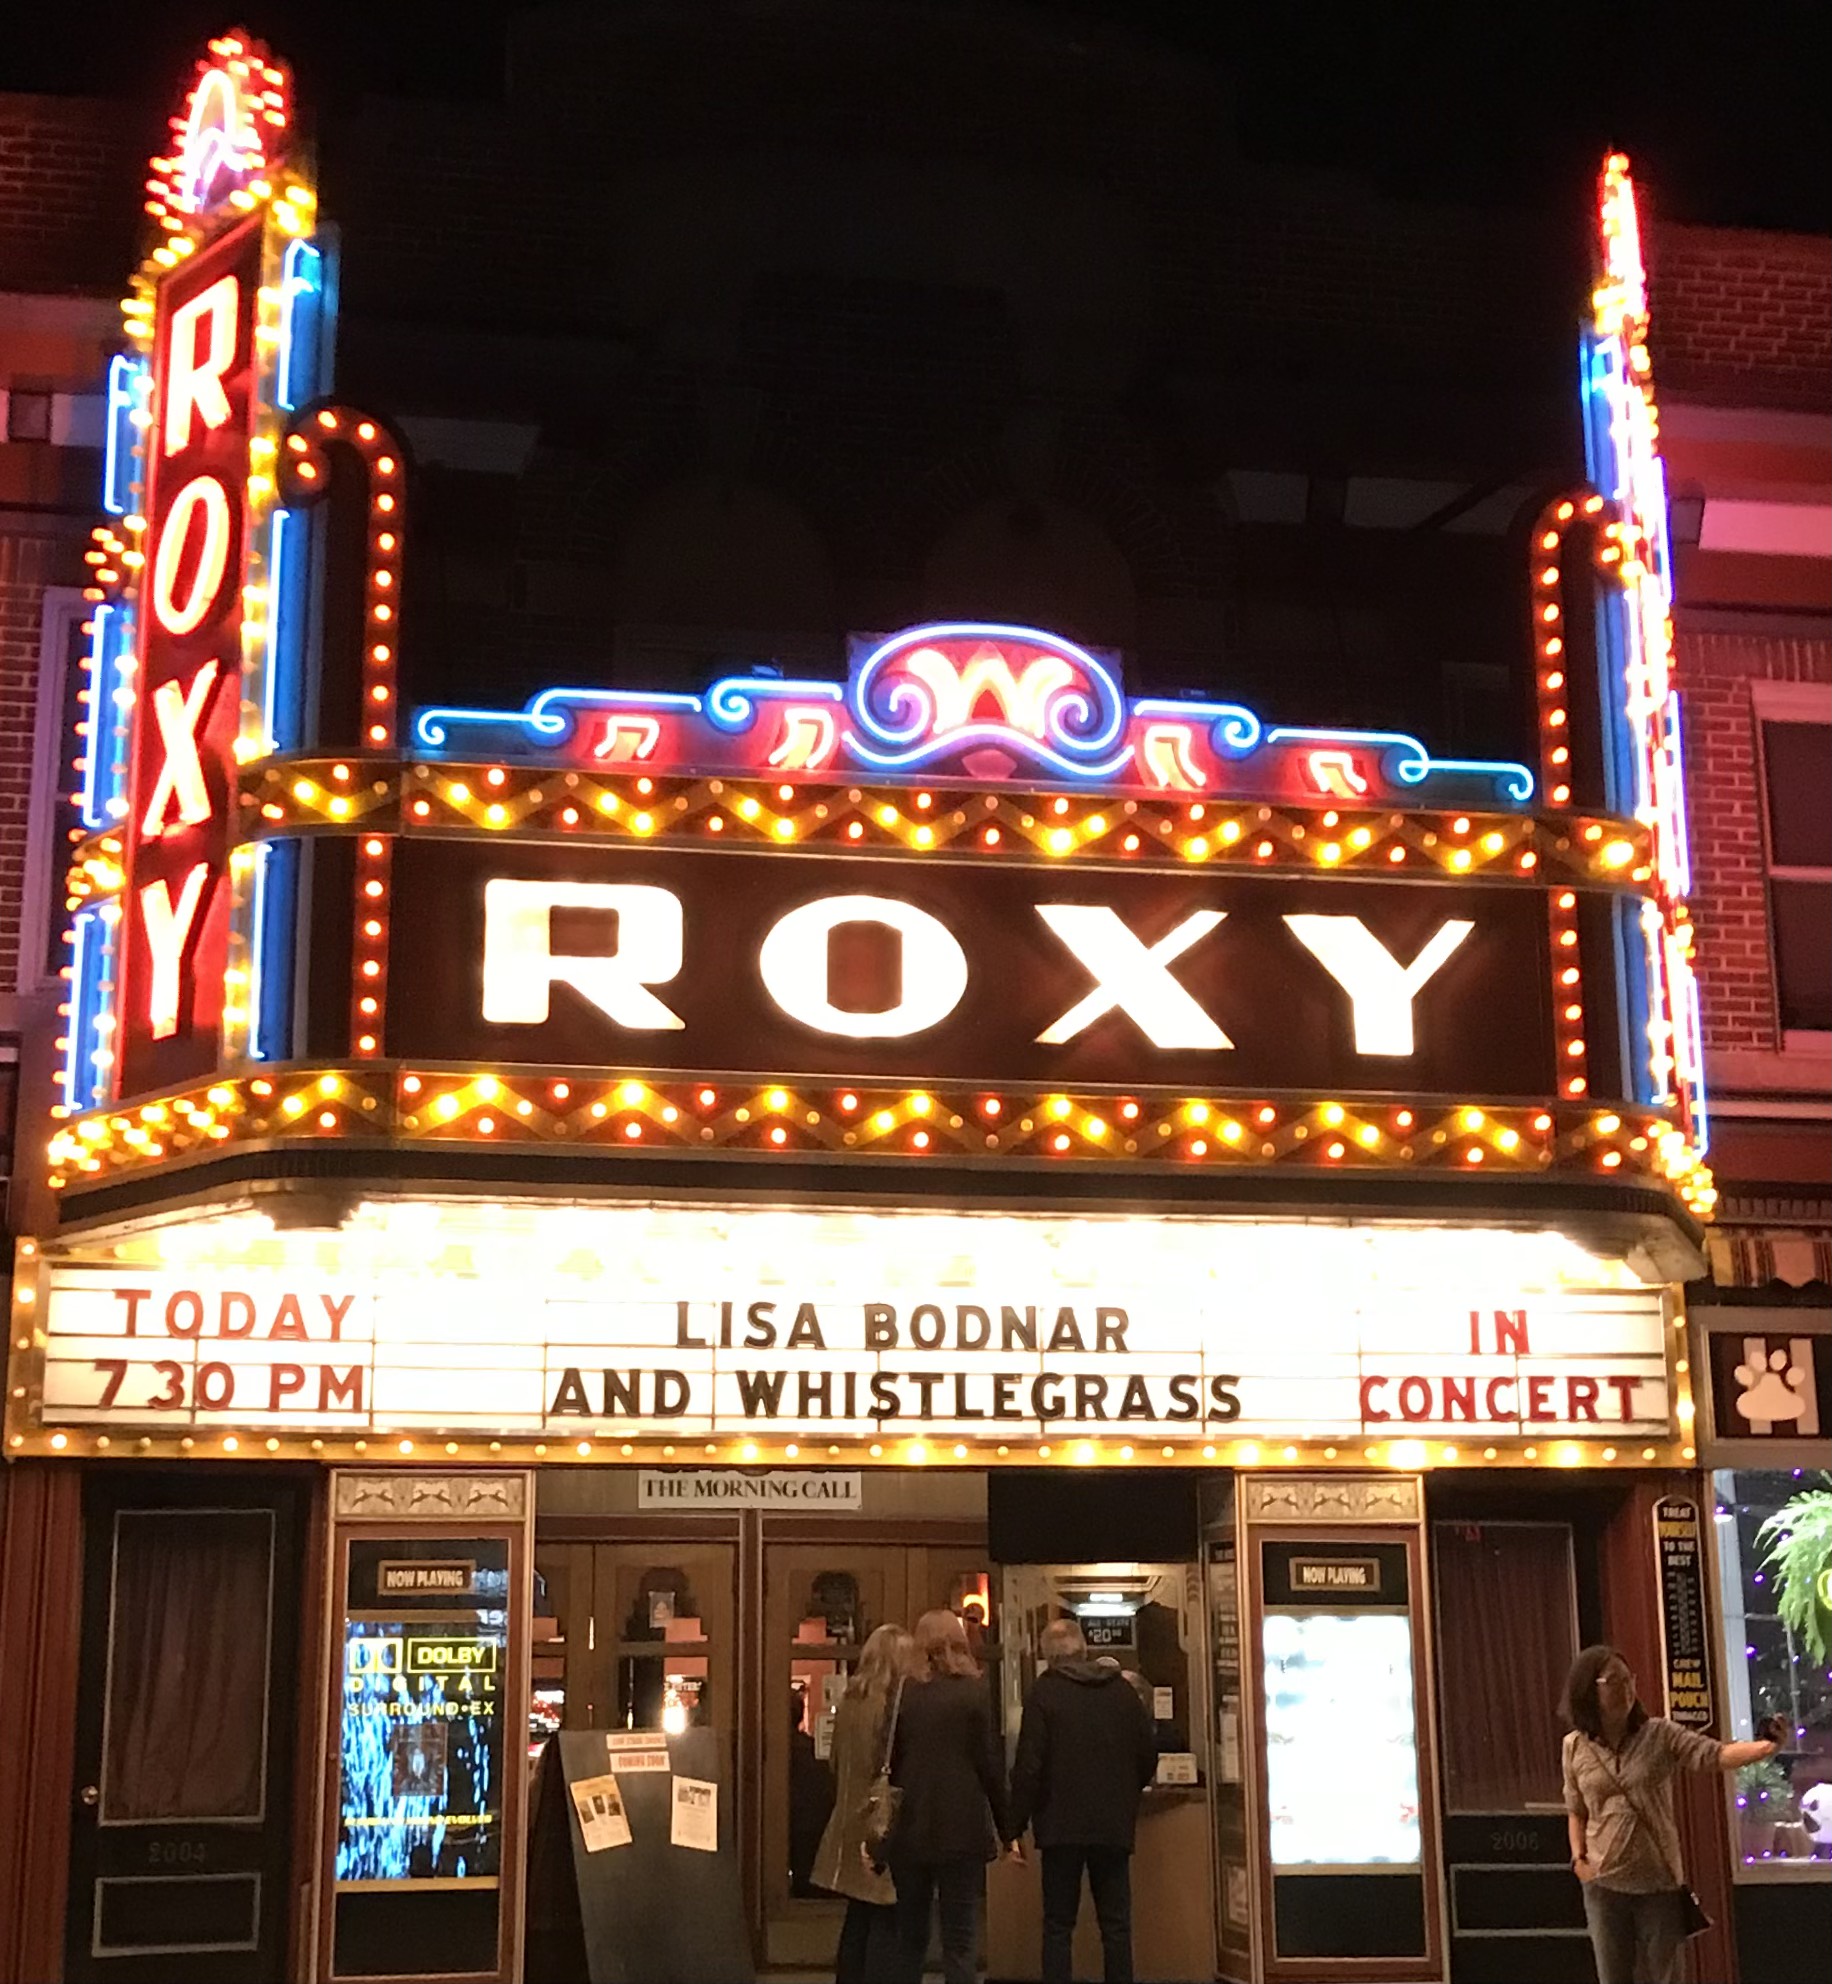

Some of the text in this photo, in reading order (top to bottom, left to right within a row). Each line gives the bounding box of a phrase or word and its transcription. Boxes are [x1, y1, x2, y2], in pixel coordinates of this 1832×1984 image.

[140, 273, 238, 1040] ROXY
[482, 878, 1476, 1056] ROXY
[113, 1289, 355, 1342] TODAY
[676, 1301, 1130, 1353] LISA BODNAR
[1469, 1309, 1530, 1355] IN
[94, 1359, 363, 1413] 730 PM
[550, 1368, 1242, 1423] AND WHISTLEGRASS
[1359, 1375, 1641, 1423] CONCERT
[643, 1479, 857, 1499] THE MORNING CALL
[387, 1570, 415, 1587] NOW
[417, 1570, 463, 1587] PLAYING
[1303, 1566, 1366, 1584] NOW PLAYING
[417, 1647, 485, 1664] DOLBY
[351, 1676, 495, 1692] DIGITAL
